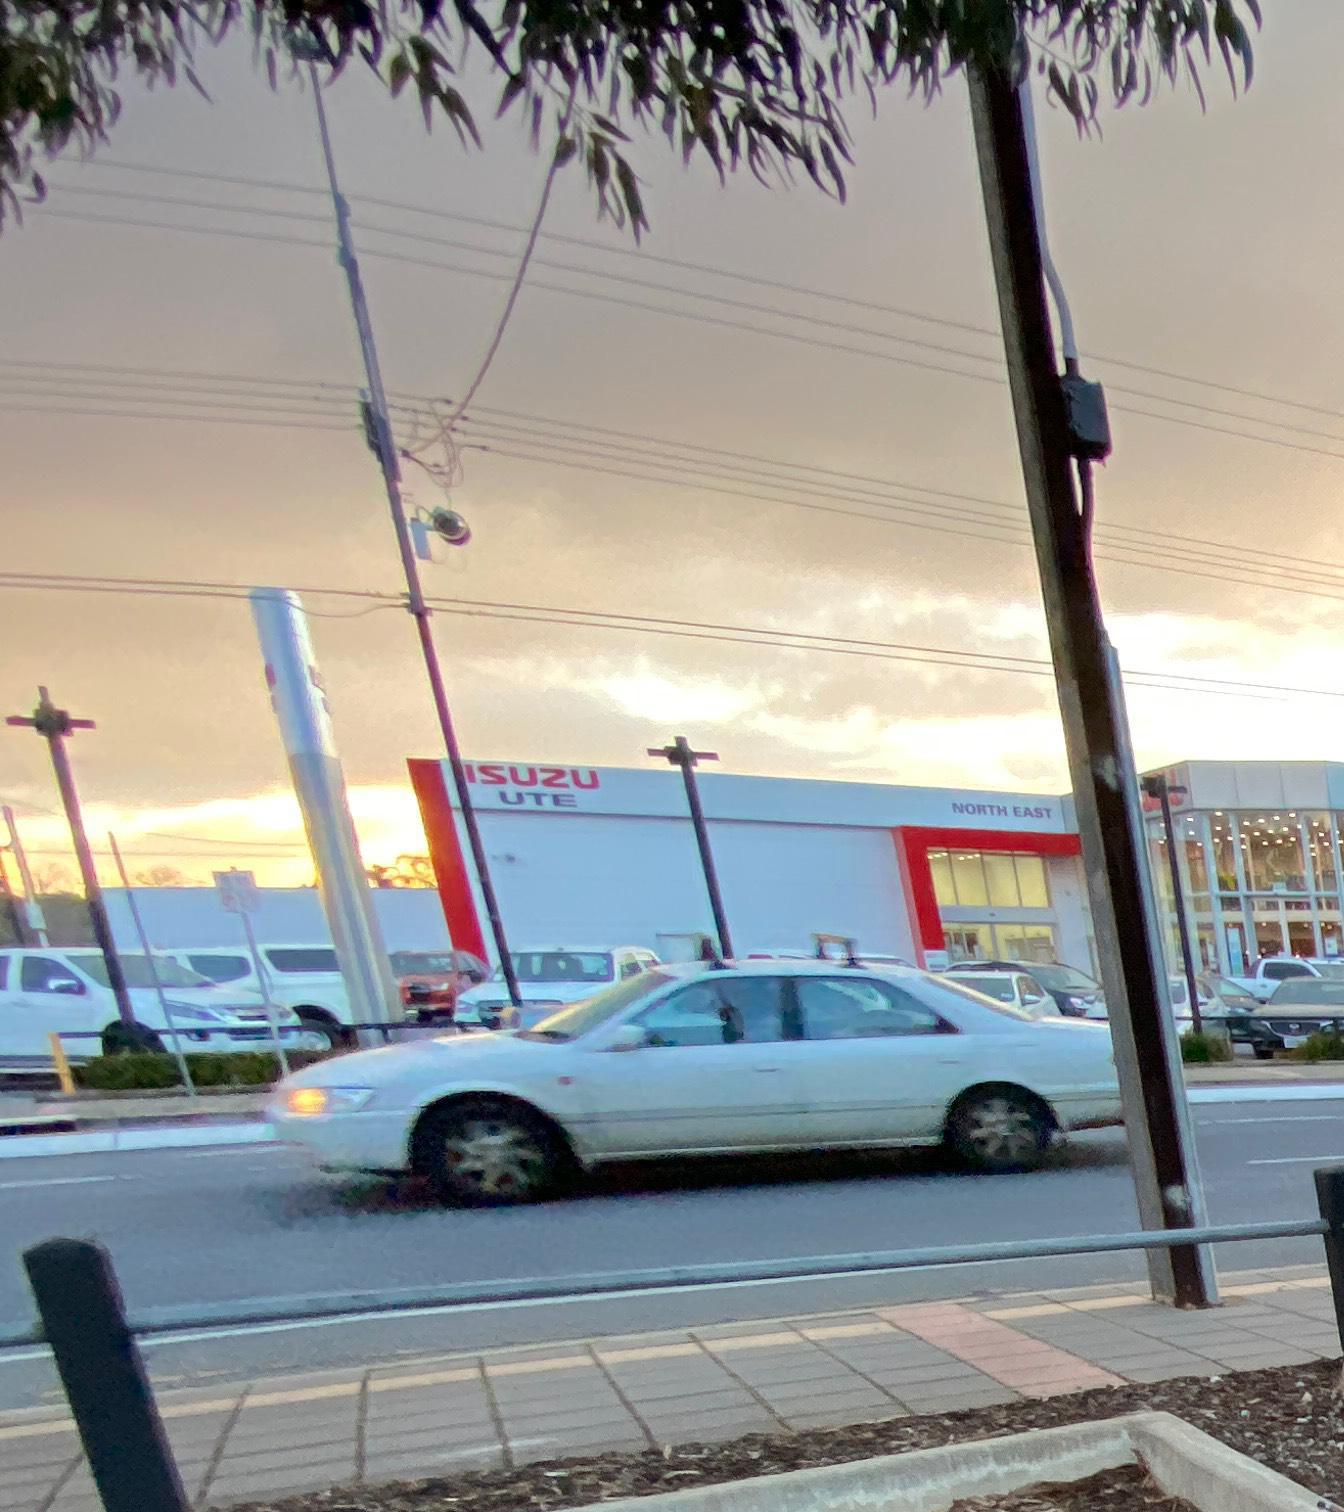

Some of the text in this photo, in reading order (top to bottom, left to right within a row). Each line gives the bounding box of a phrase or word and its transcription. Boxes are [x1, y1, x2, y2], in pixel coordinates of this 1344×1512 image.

[463, 763, 600, 790] ISUZU
[499, 790, 578, 808] UTE
[951, 802, 1053, 819] NORTH EAST
